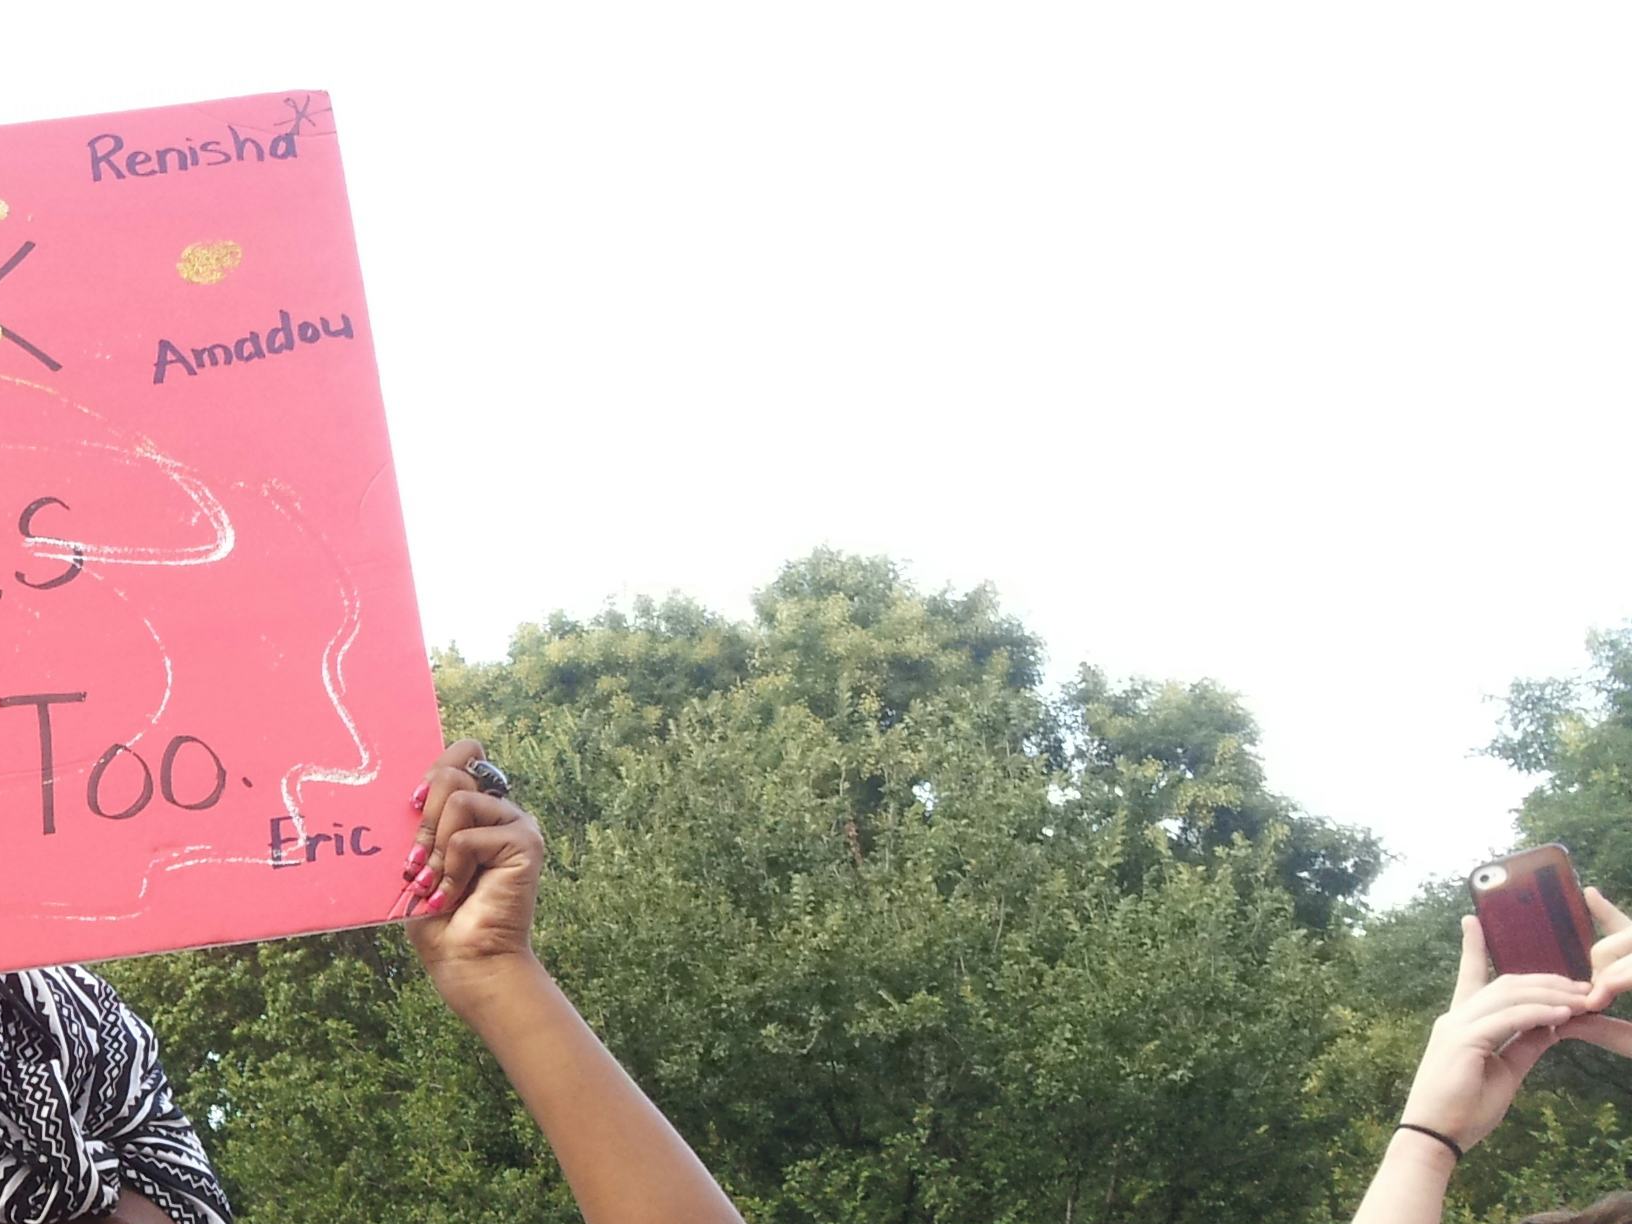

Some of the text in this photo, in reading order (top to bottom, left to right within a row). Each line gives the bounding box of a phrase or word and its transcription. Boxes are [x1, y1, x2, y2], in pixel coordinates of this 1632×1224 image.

[87, 125, 299, 183] Renisha
[153, 308, 355, 385] Amadou
[268, 815, 383, 869] Eric
